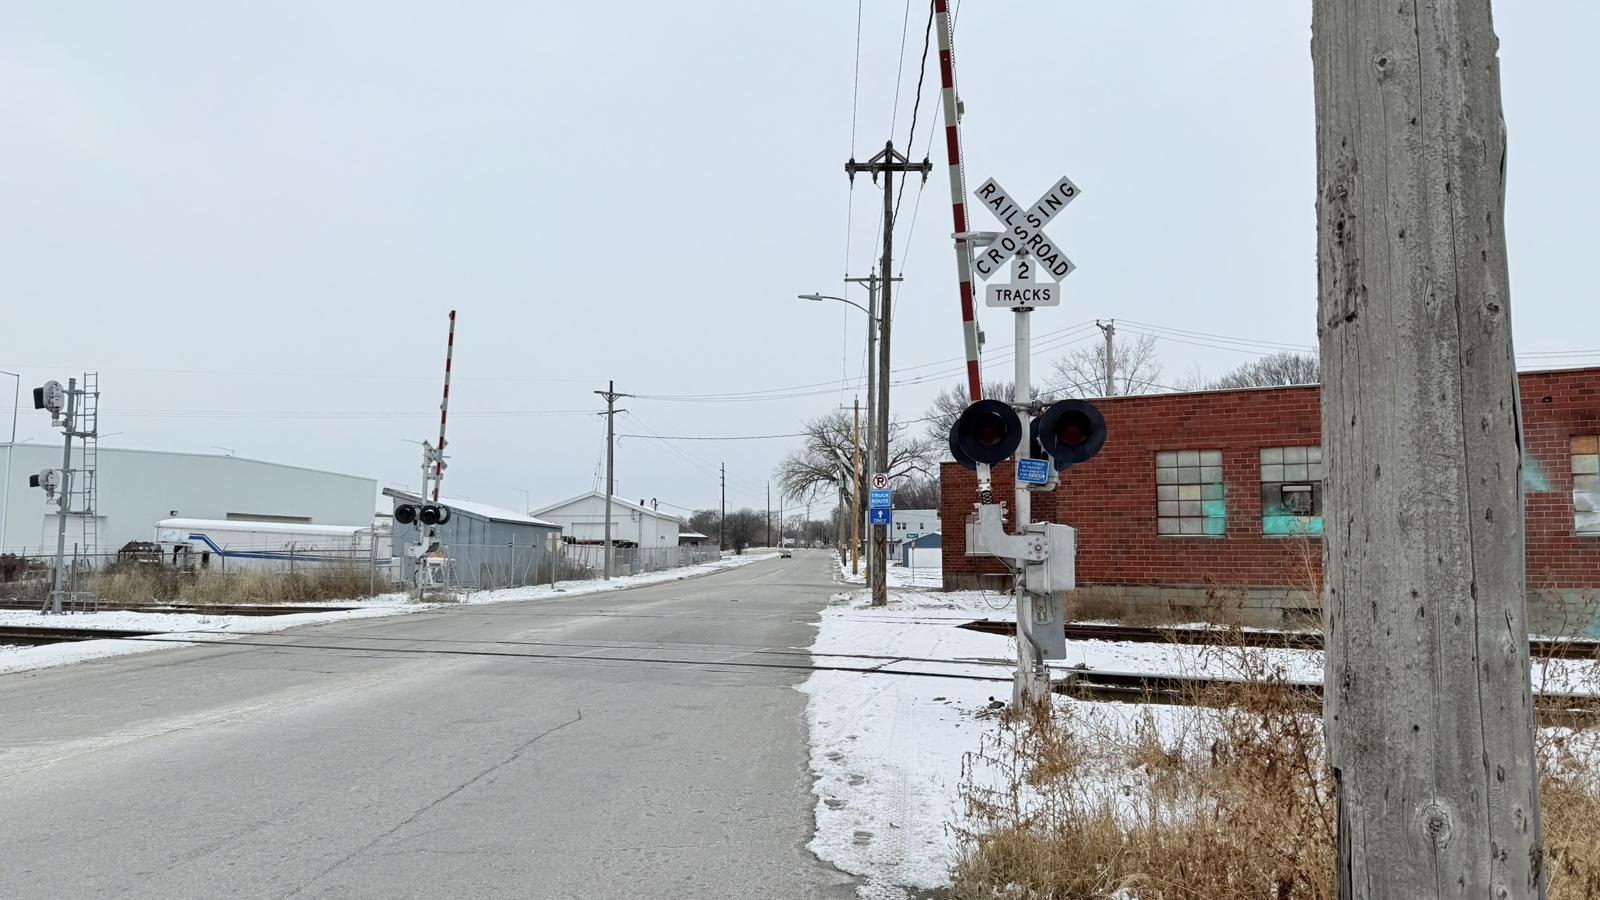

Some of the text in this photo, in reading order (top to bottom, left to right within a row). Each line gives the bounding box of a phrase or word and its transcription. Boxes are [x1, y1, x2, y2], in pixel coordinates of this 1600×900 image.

[976, 183, 1074, 274] CROSSING
[980, 182, 1068, 276] RAILROAD
[995, 289, 1051, 301] TRACKS
[1018, 261, 1029, 279] 2
